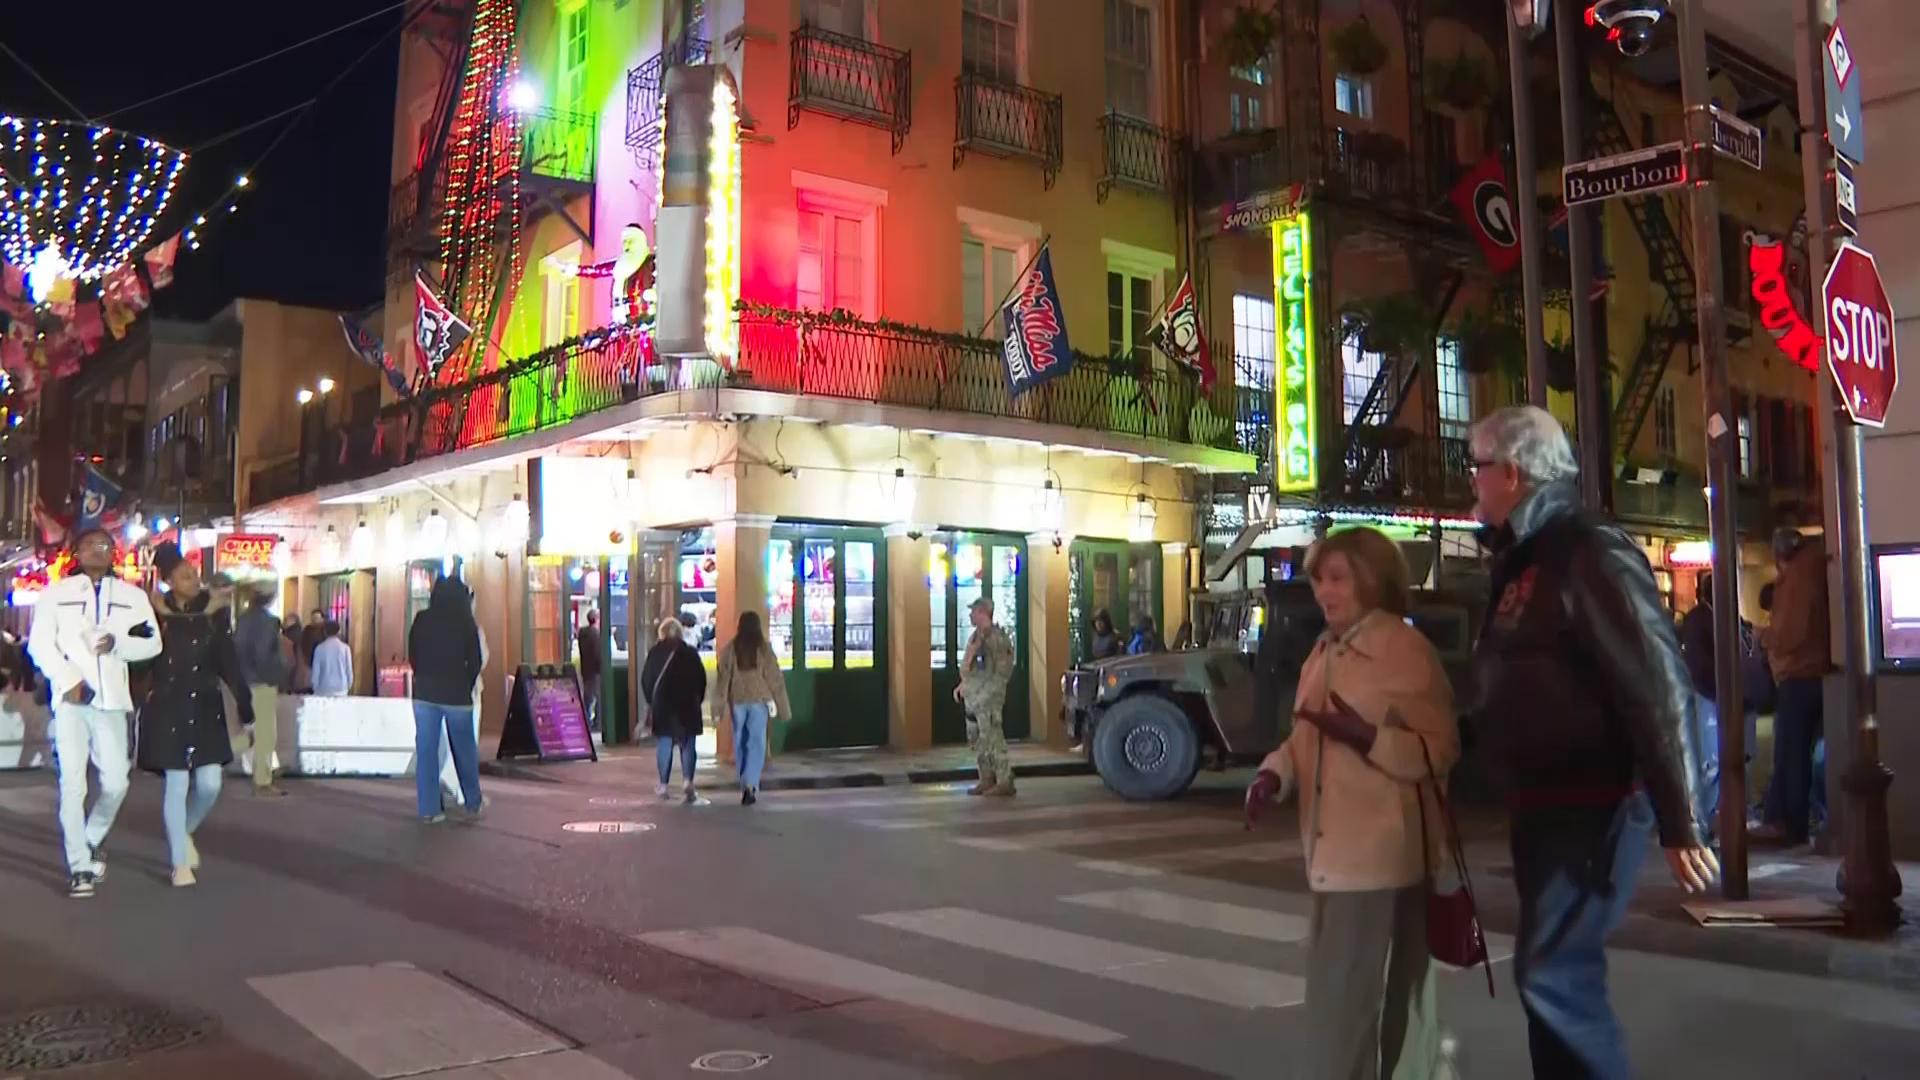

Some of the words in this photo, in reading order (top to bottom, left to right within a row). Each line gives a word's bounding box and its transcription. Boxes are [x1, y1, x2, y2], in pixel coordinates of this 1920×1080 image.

[1712, 119, 1758, 161] berville
[1569, 164, 1680, 200] Bourbon
[1022, 296, 1061, 372] Miss
[1832, 296, 1891, 371] STOP
[1006, 330, 1028, 382] TODDY
[1286, 402, 1309, 476] BAR
[1247, 493, 1271, 519] IV
[1249, 485, 1269, 494] KEEP
[221, 551, 275, 568] FACTOR
[224, 539, 272, 553] CIGAR
